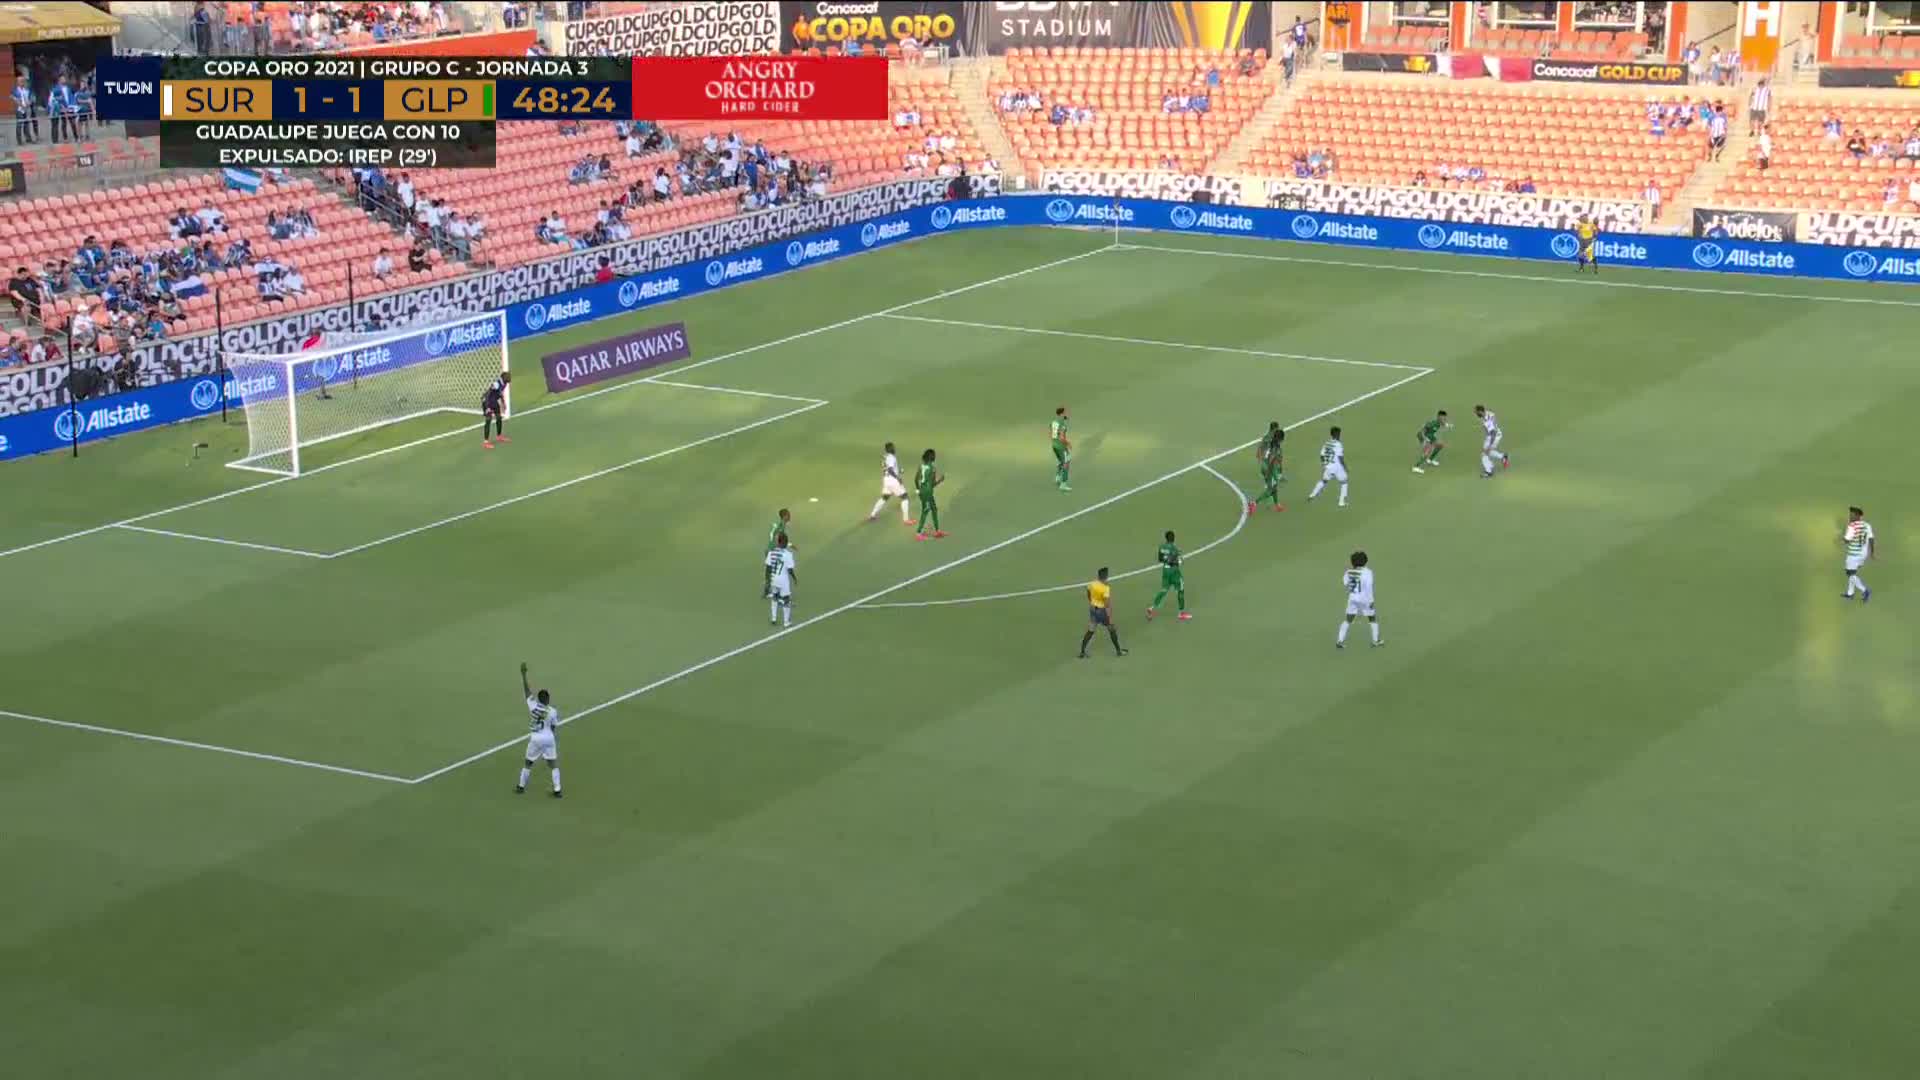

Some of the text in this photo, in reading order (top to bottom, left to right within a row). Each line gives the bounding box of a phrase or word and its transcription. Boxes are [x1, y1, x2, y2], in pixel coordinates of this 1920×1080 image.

[816, 2, 879, 15] Concacaf
[809, 15, 955, 42] COPA ORO
[1001, 19, 1111, 36] STADIUM
[1534, 63, 1682, 81] Concacaf GOLD CUP
[951, 205, 1006, 224] Allstate
[1074, 204, 1134, 221] Allstate
[1196, 211, 1253, 231] Allstate
[877, 219, 911, 240] Allstate
[1319, 221, 1378, 240] Allstate
[1446, 230, 1508, 250] Allstate
[803, 238, 840, 259] Allstate
[1594, 241, 1647, 260] llstate
[1725, 248, 1795, 270] Allstate
[724, 256, 763, 279] Allstate
[638, 276, 681, 300] Allstate
[547, 297, 591, 322] Allstate
[338, 347, 393, 373] Alstate
[555, 330, 685, 382] QATAR AIRWAYS
[86, 402, 151, 433] Allstate
